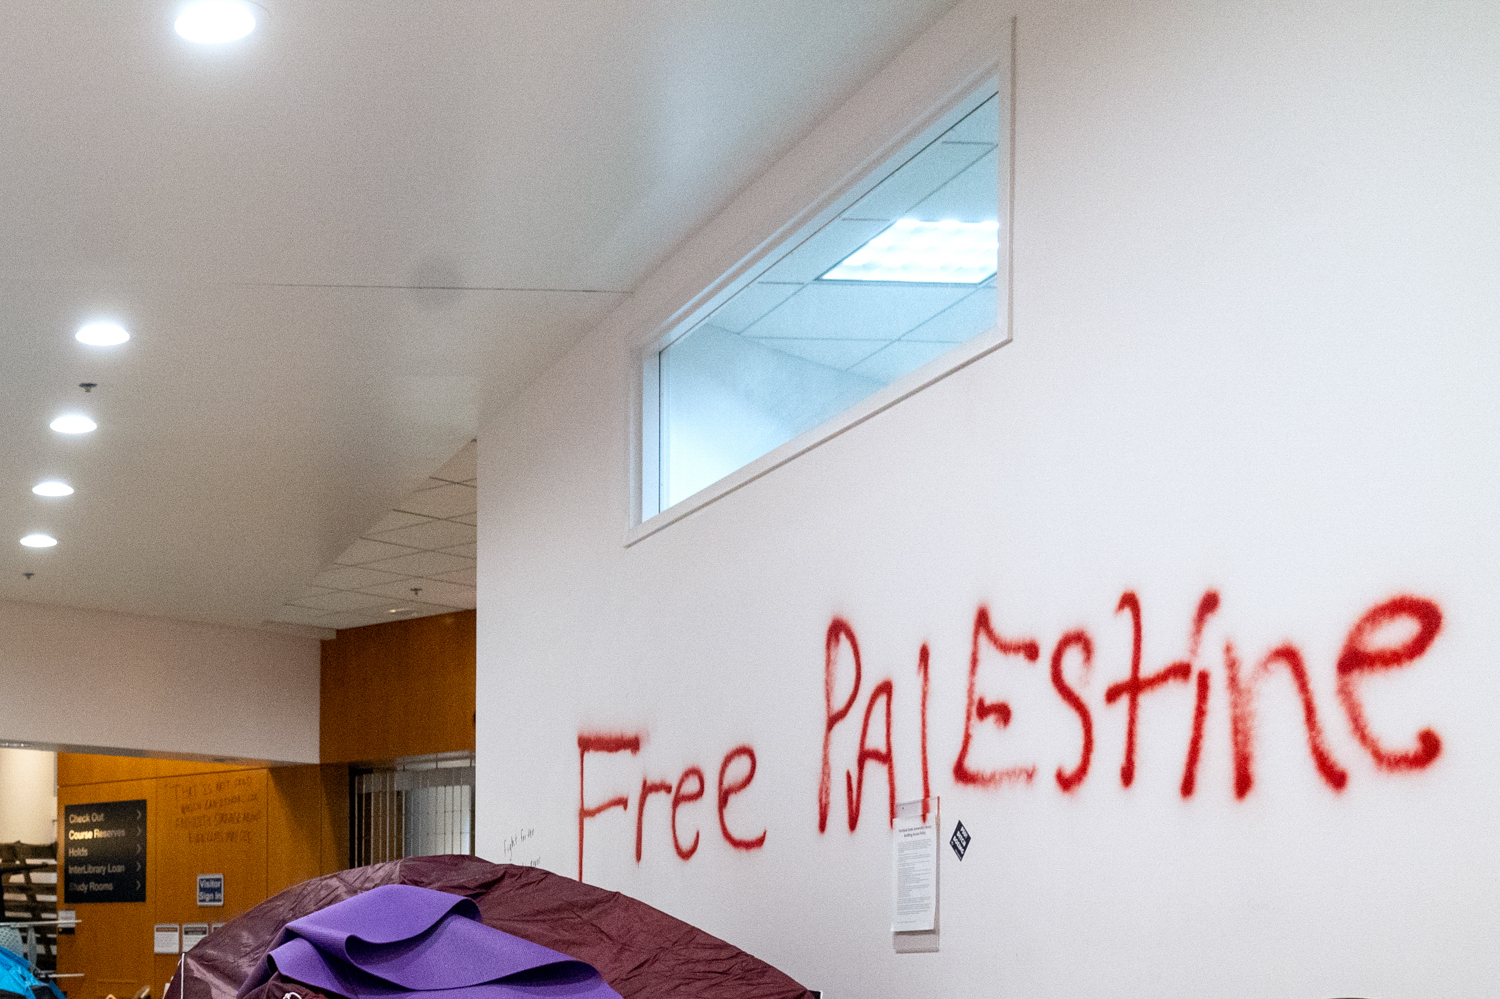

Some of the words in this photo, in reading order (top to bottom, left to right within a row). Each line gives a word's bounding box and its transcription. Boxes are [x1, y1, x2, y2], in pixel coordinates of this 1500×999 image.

[576, 734, 768, 882] Free
[69, 814, 90, 823] Check
[91, 812, 104, 822] Out
[69, 830, 93, 840] Course
[94, 829, 125, 838] Reserves
[68, 847, 88, 857] Holds
[107, 863, 125, 873] Loan
[89, 881, 113, 891] Rooms
[199, 879, 221, 888] Visitor
[199, 892, 214, 902] Sign
